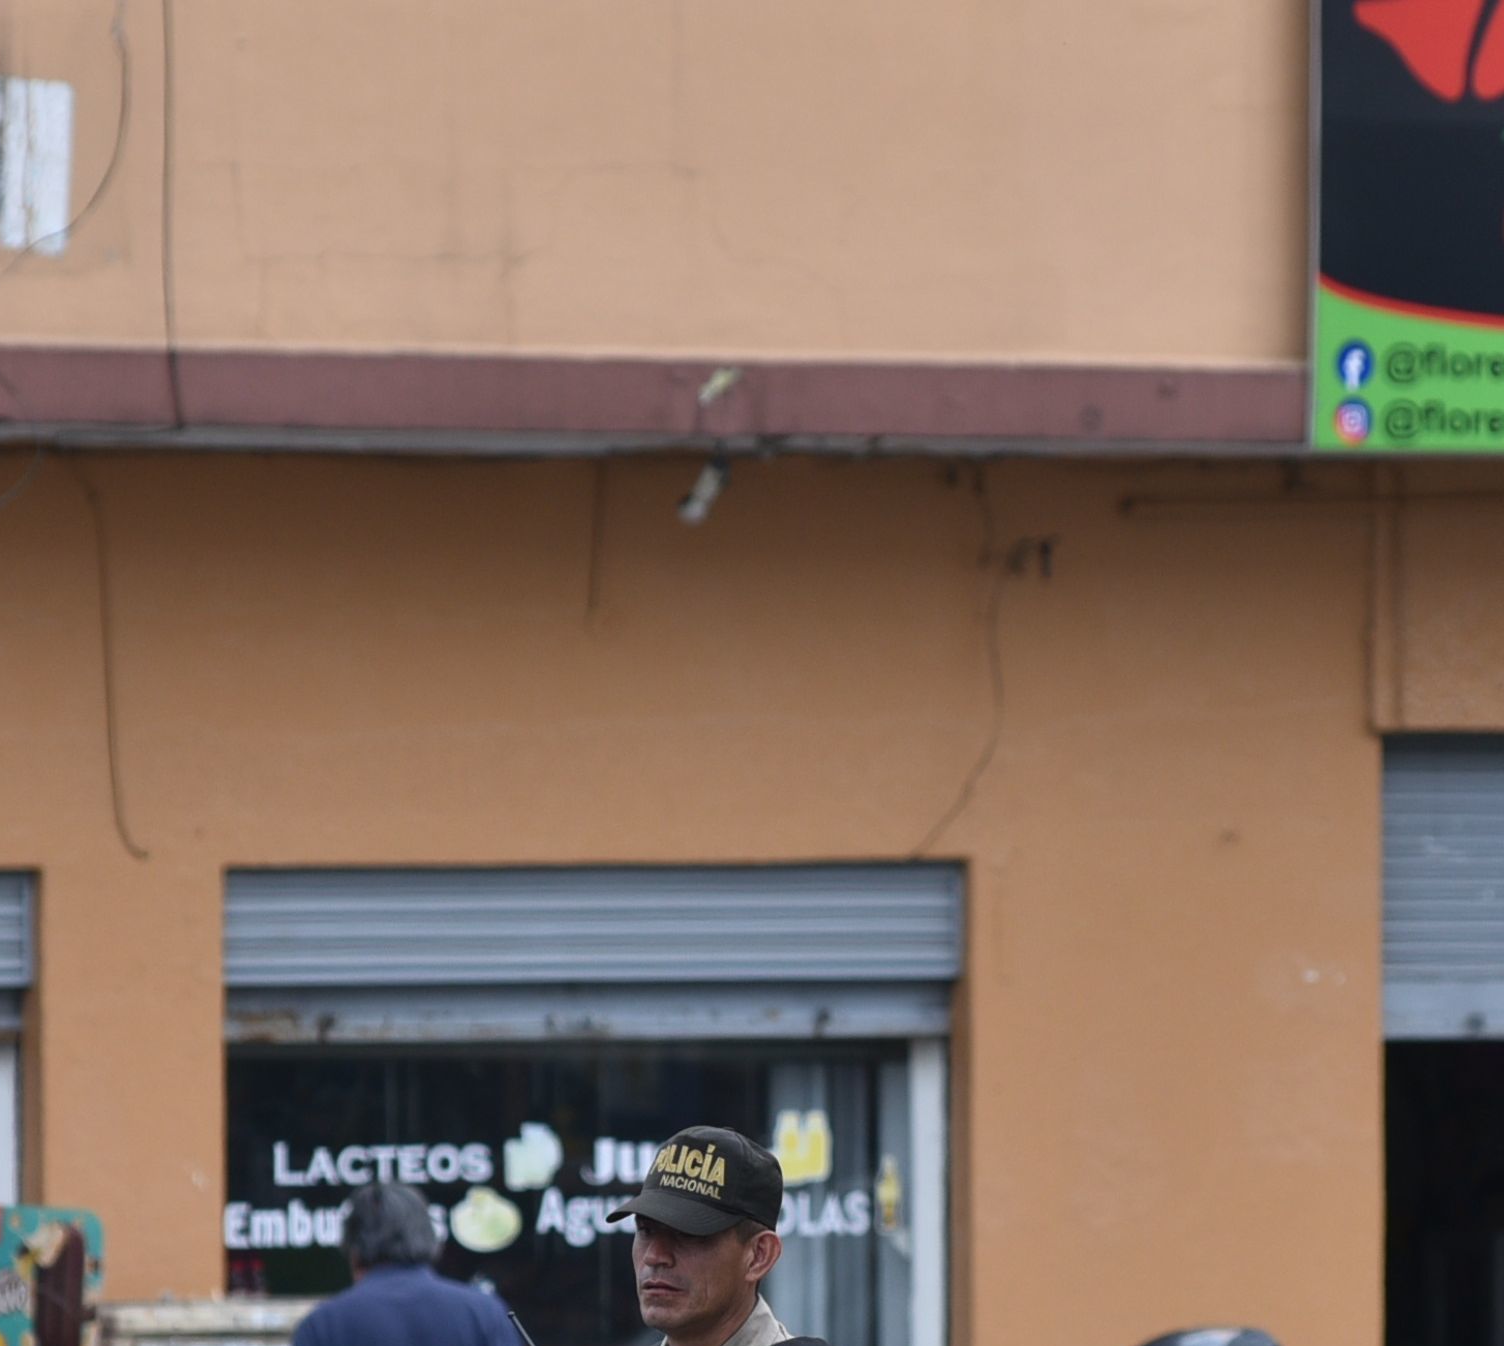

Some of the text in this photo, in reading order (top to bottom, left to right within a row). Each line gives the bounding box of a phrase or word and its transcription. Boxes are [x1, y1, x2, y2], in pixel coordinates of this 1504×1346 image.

[272, 1140, 494, 1186] LACTEOS
[579, 1136, 659, 1186] Ju
[659, 1174, 721, 1200] NACIONAL
[776, 1190, 871, 1237] OLAS
